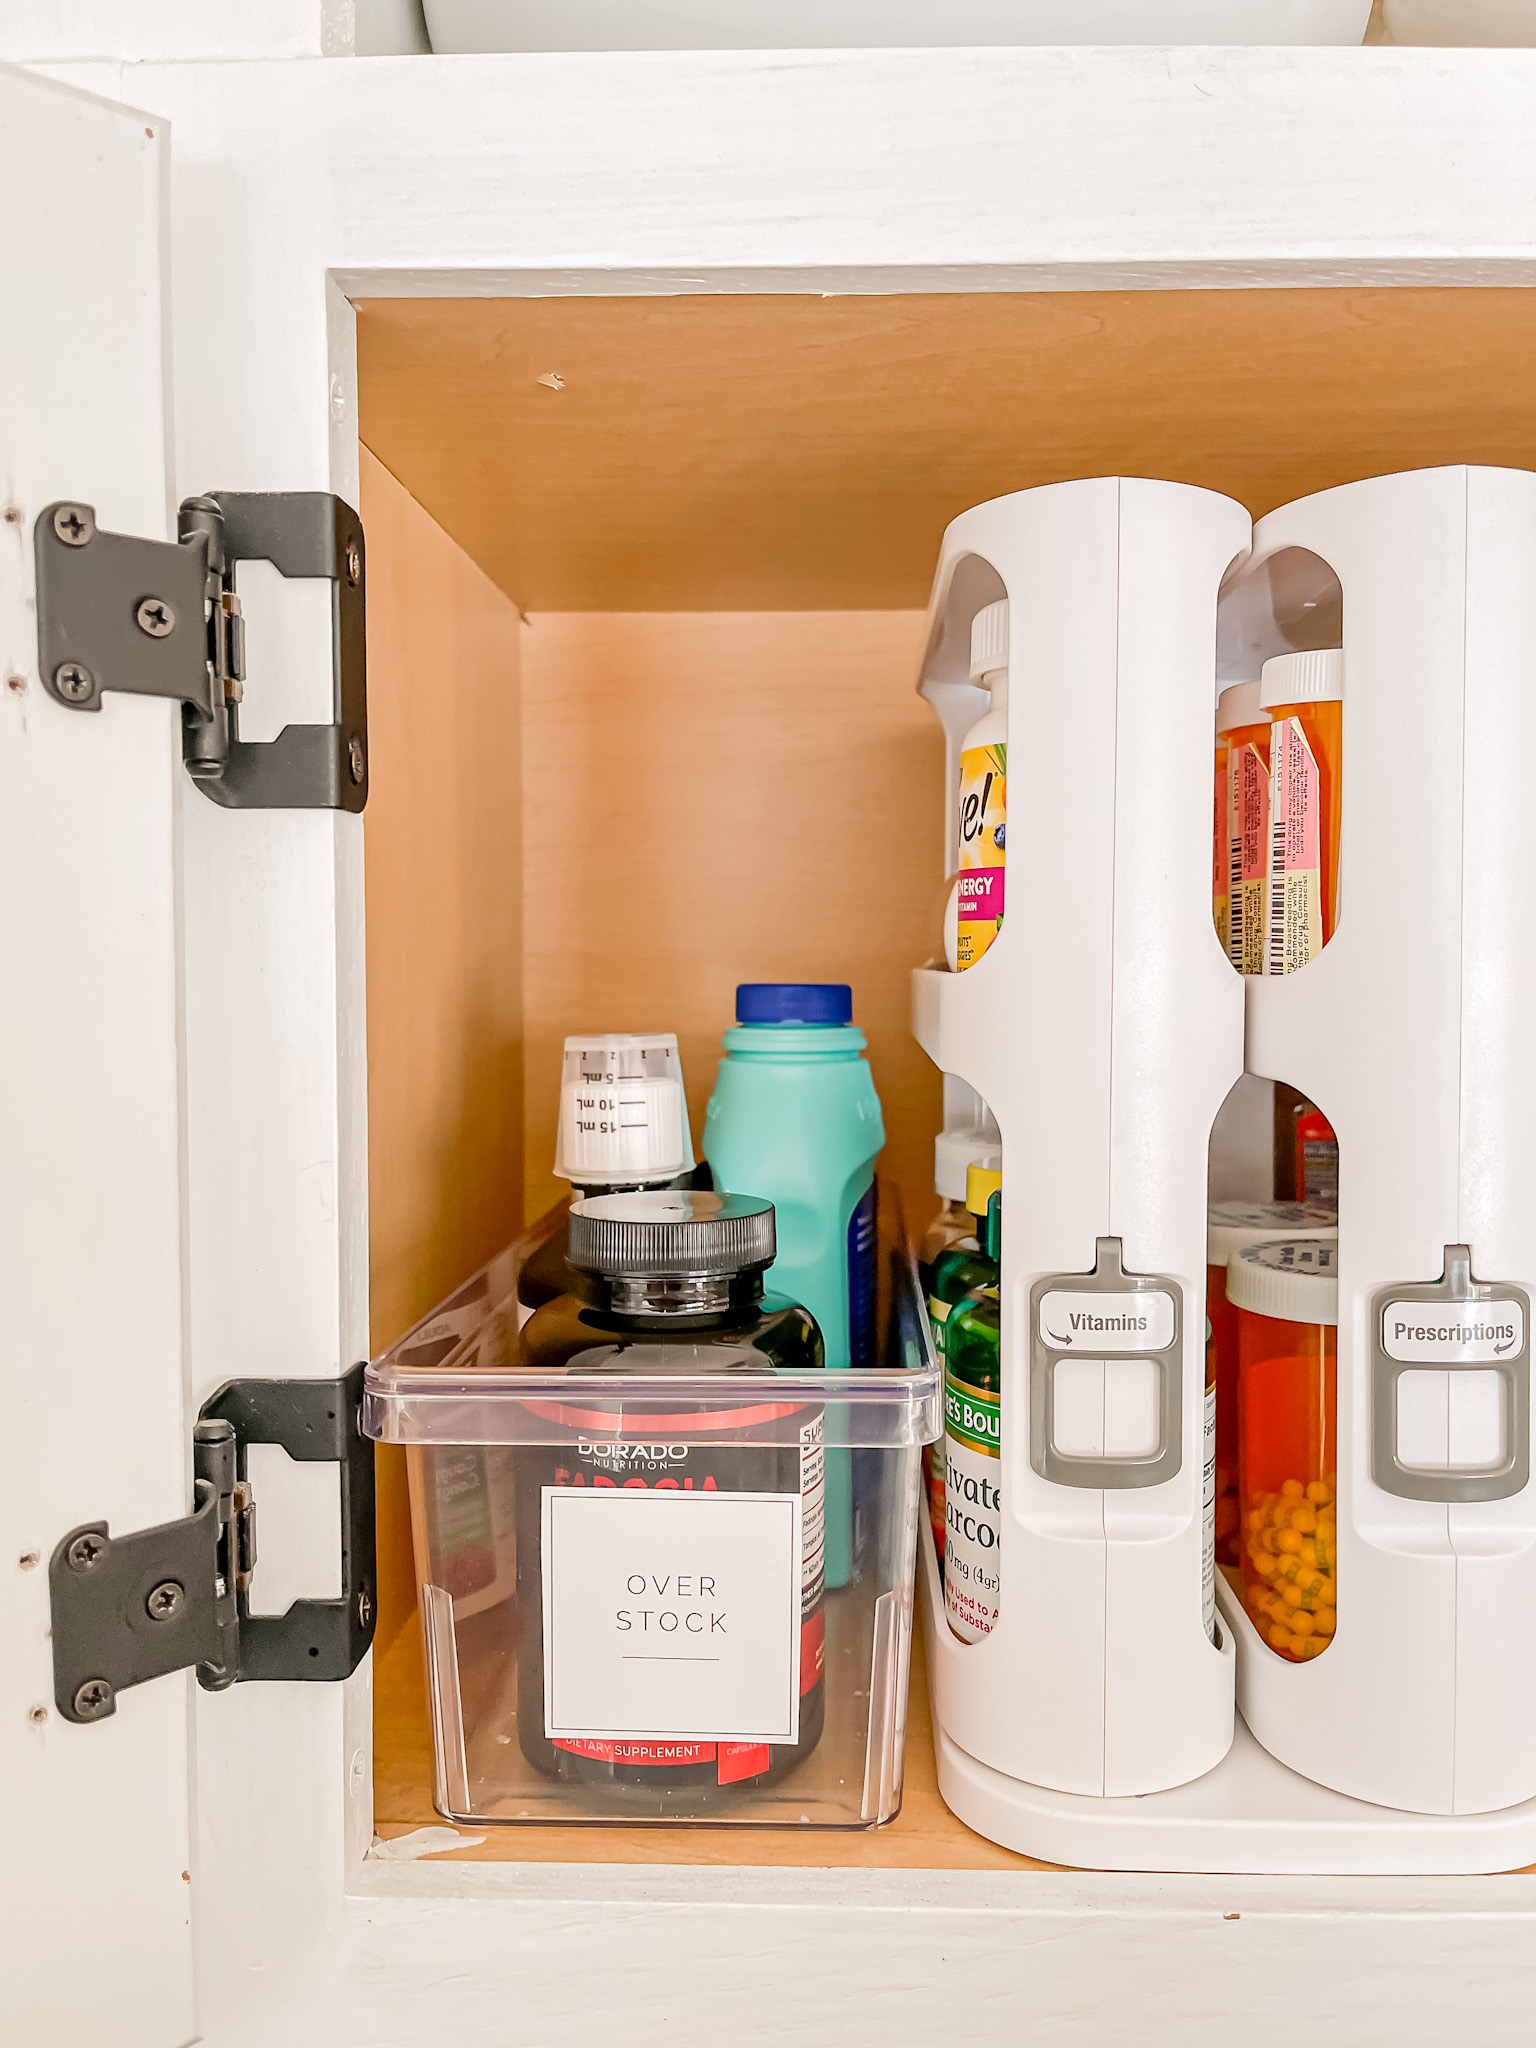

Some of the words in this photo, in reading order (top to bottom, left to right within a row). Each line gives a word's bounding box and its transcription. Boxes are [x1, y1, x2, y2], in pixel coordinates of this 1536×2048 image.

[958, 876, 994, 896] NERGY
[1287, 876, 1292, 885] is
[599, 1099, 615, 1111] 10
[600, 1122, 616, 1133] 15
[1069, 1313, 1147, 1331] Vitamins
[1394, 1322, 1514, 1345] Prescriptions
[578, 1436, 688, 1460] DORADO
[593, 1458, 668, 1471] NUTRITION
[946, 1500, 1000, 1550] arco
[627, 1574, 716, 1597] OVER
[955, 1588, 974, 1610] Used
[977, 1600, 988, 1616] to
[616, 1610, 727, 1633] STOCK
[614, 1744, 701, 1758] SUPPLEMENT
